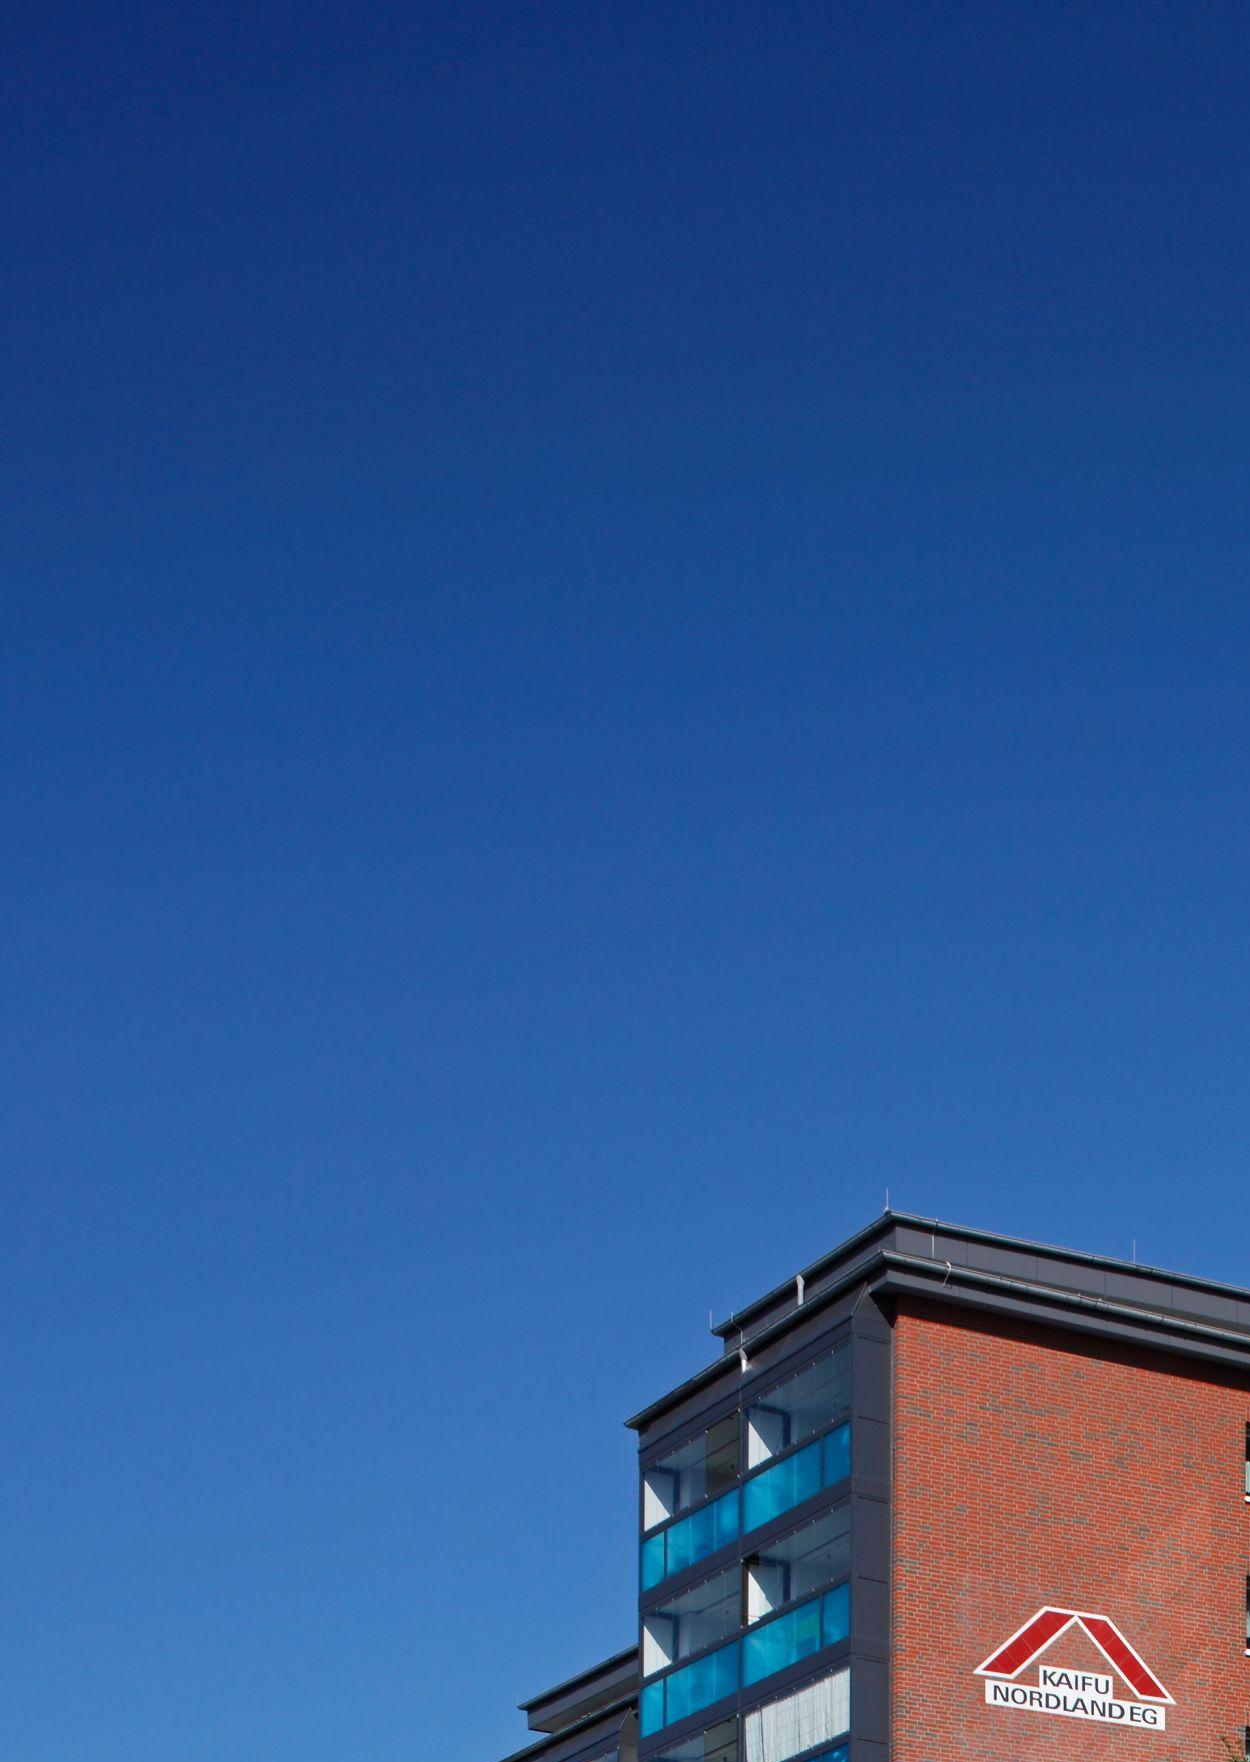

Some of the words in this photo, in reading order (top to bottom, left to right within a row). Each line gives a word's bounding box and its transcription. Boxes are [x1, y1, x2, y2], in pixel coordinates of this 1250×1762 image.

[1042, 1669, 1109, 1695] KAIFU
[993, 1685, 1125, 1720] NORDLAND
[1129, 1706, 1158, 1725] EG
